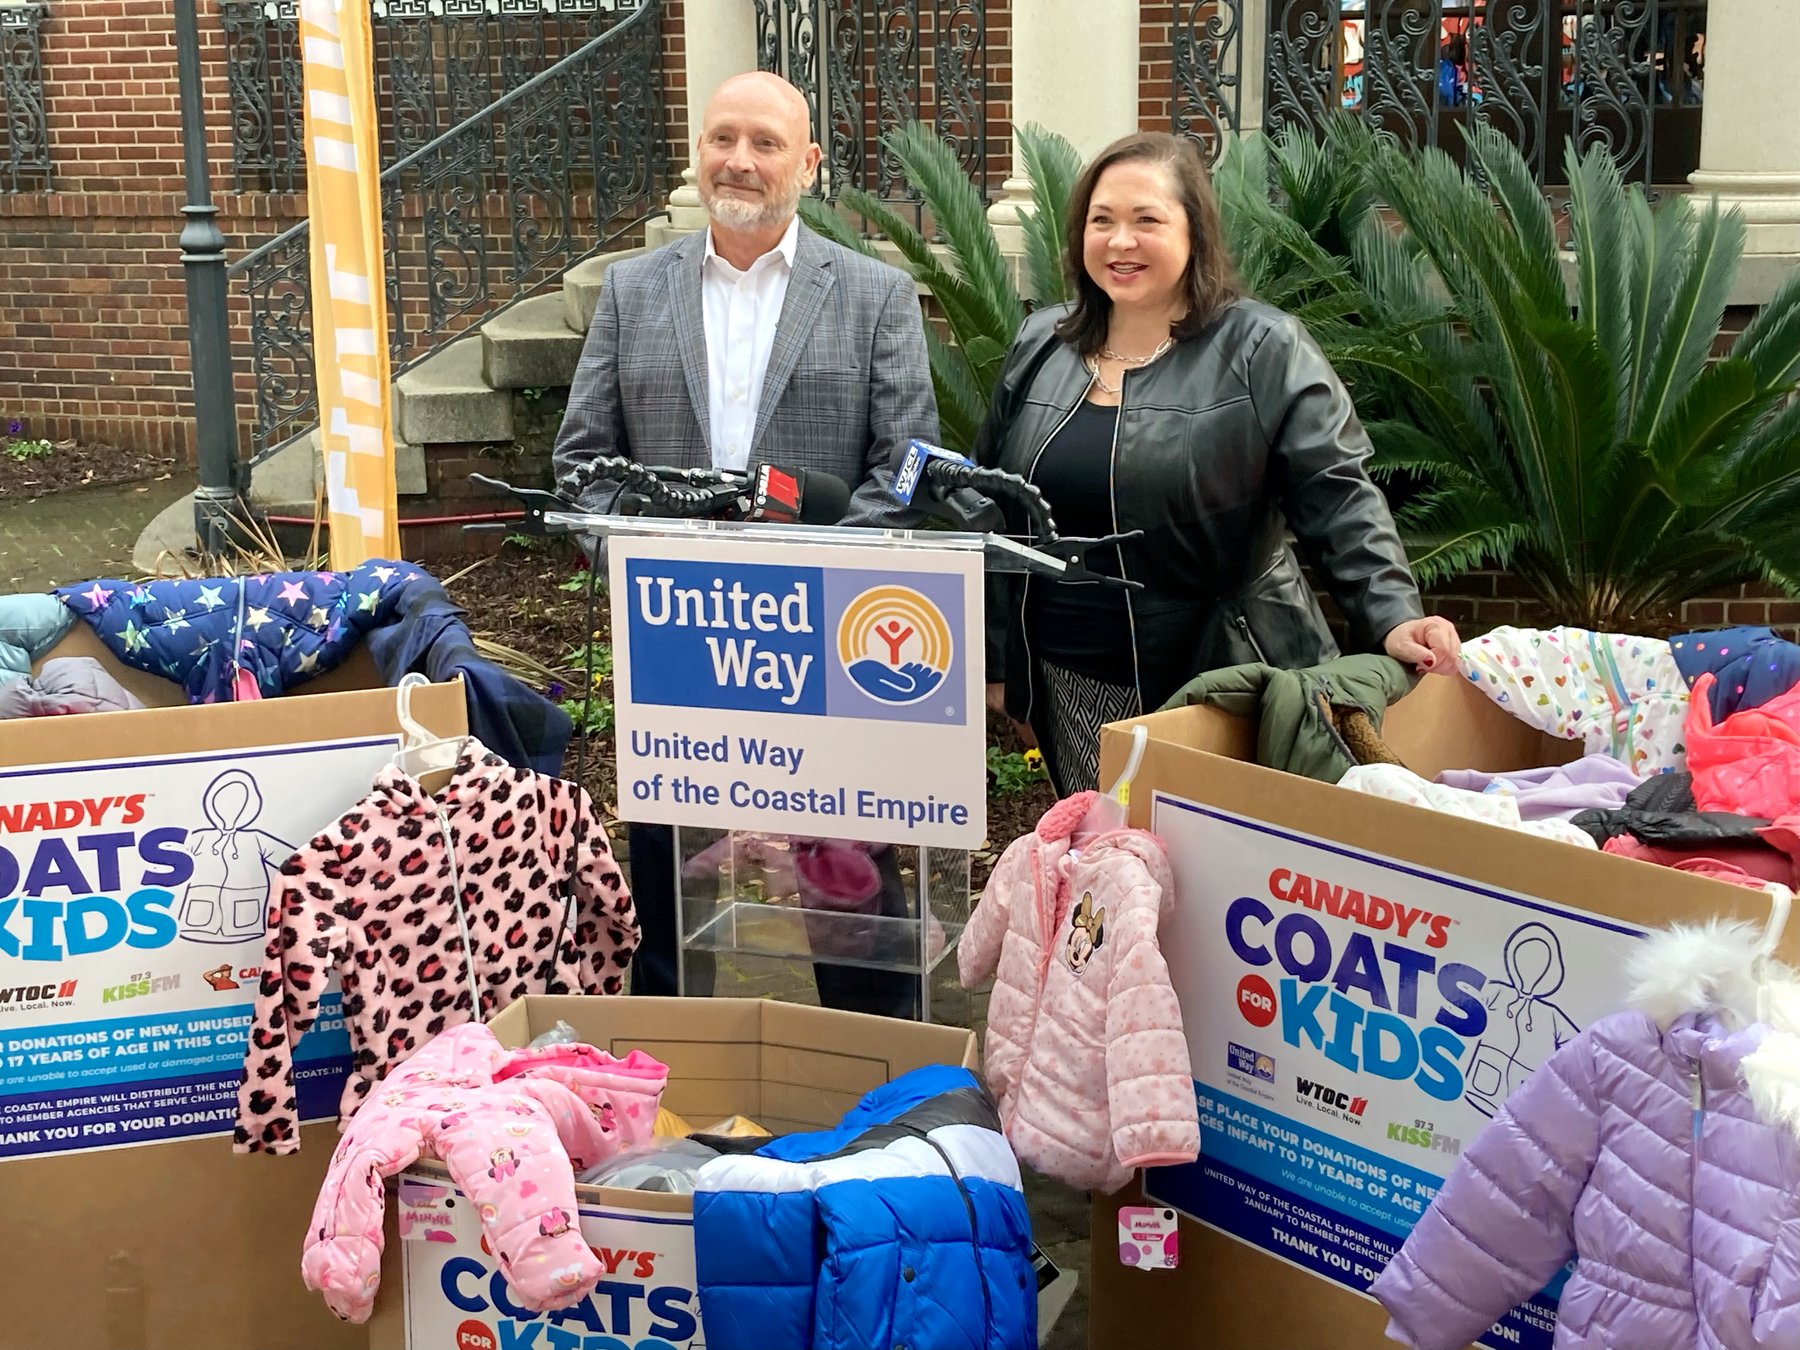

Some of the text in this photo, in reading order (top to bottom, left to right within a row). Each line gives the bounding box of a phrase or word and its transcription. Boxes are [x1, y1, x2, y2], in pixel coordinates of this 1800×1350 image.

[636, 576, 813, 633] United
[706, 637, 813, 705] Way
[632, 730, 804, 774] United Way
[633, 774, 968, 828] of the Coastal Empire
[1269, 868, 1452, 949] CANADY'S
[131, 971, 152, 982] 97.3
[1226, 897, 1487, 1037] COATS
[20, 1001, 48, 1010] Local.
[1241, 988, 1272, 1012] FOR
[7, 1055, 24, 1068] 17
[29, 1049, 84, 1065] YEARS
[88, 1046, 110, 1060] OF
[115, 1042, 149, 1056] AGE
[153, 1040, 170, 1052] IN
[174, 1035, 212, 1050] THIS
[8, 1031, 108, 1052] DONATIONS
[112, 1028, 135, 1041] OF
[139, 1023, 184, 1038] NEW,
[187, 1015, 253, 1034] UNUSED
[1230, 1044, 1254, 1062] United
[1280, 979, 1466, 1102] KIDS
[6, 1076, 25, 1084] are
[28, 1071, 65, 1082] unable
[67, 1070, 79, 1078] to
[81, 1066, 117, 1076] accept
[120, 1062, 146, 1072] used
[149, 1061, 160, 1069] or
[161, 1055, 214, 1067] damaged
[1238, 1058, 1254, 1074] Way
[4, 1101, 53, 1114] COASTAL
[56, 1096, 97, 1108] EMPIRE
[100, 1093, 127, 1103] WILL
[130, 1085, 192, 1099] DISTRIBUTE
[195, 1082, 216, 1092] THE
[295, 1067, 328, 1079] COATS
[331, 1066, 343, 1074] IN
[16, 1111, 63, 1122] MEMBER
[66, 1104, 120, 1117] AGENCIES
[123, 1101, 151, 1111] THAT
[153, 1096, 188, 1107] SERVE
[1296, 1076, 1349, 1110] WTOC
[44, 1126, 79, 1140] YOU
[83, 1122, 116, 1136] FOR
[120, 1116, 166, 1132] YOUR
[1296, 1095, 1363, 1127] Live. Local. Now.
[1414, 1119, 1434, 1131] 97.3
[1199, 1113, 1422, 1214] GES INFANT TO 17 YEARS OF AGE
[1217, 1103, 1259, 1130] PLACE
[1261, 1121, 1299, 1147] YOUR
[1303, 1138, 1387, 1182] DONATIONS
[1391, 1173, 1412, 1190] OF
[1281, 1169, 1296, 1181] We
[1297, 1177, 1313, 1188] are
[1314, 1183, 1346, 1202] unable
[1348, 1197, 1358, 1207] to
[1359, 1202, 1392, 1220] accept
[1204, 1167, 1558, 1321] UNITED WAY OF THE COASTAL EMPIRE WILL NUSED
[1244, 1196, 1284, 1220] JANUARY
[1286, 1214, 1299, 1226] TO
[1300, 1221, 1340, 1245] MEMBER
[1342, 1239, 1390, 1264] AGENCIES
[1524, 1314, 1554, 1332] NEED
[1271, 1227, 1318, 1258] THANK
[1321, 1248, 1351, 1271] YOU
[460, 1332, 492, 1349] FOR
